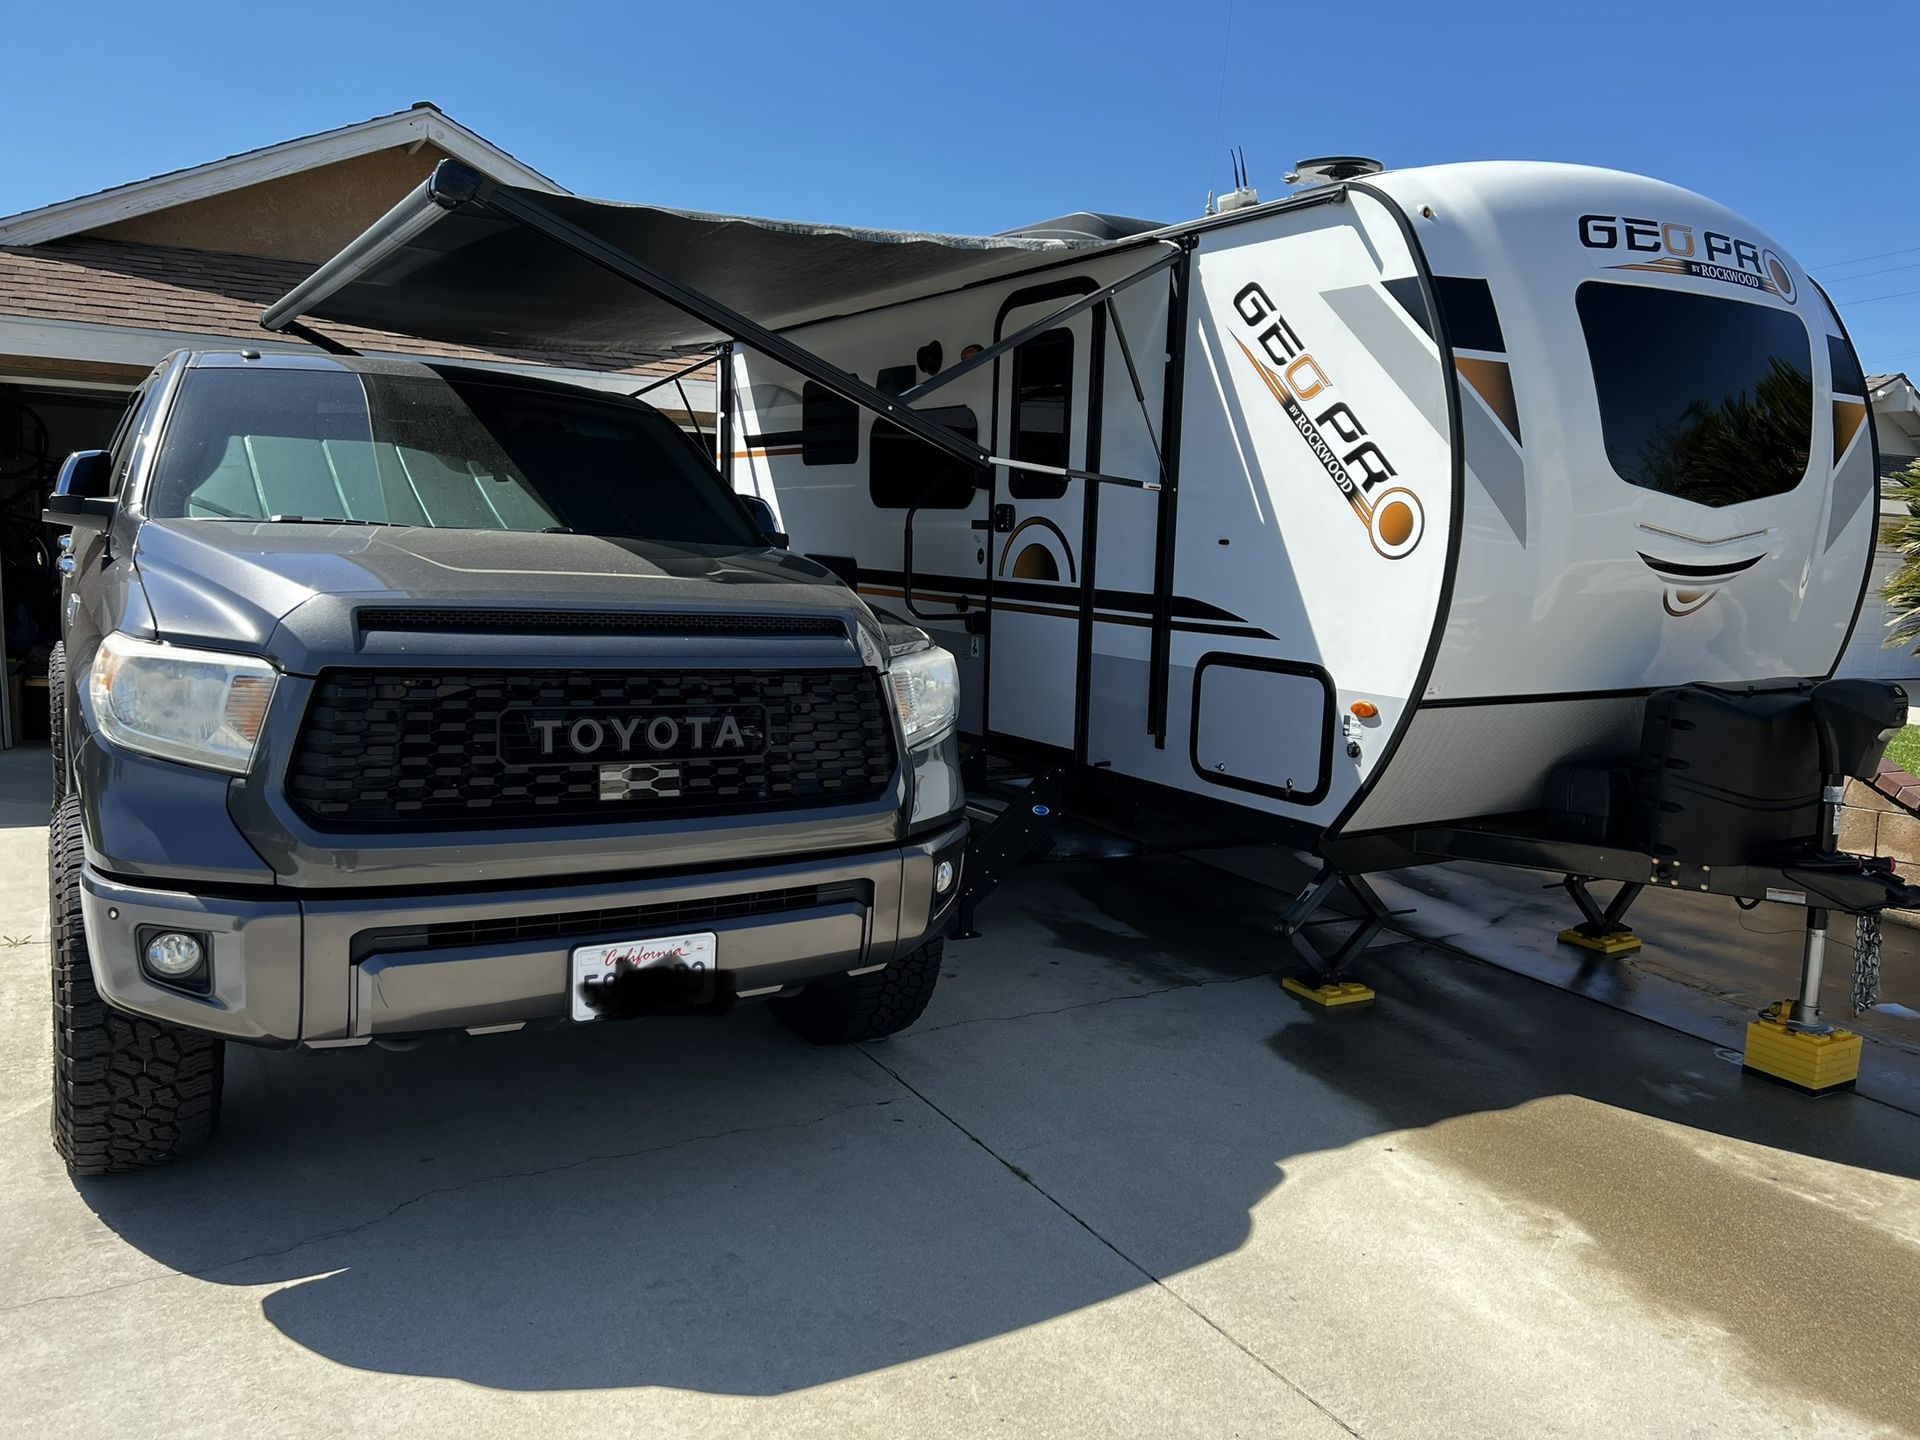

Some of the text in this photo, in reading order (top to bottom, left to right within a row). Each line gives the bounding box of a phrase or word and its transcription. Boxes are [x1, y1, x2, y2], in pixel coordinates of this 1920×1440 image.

[1578, 214, 1696, 257] GEO
[1691, 264, 1759, 287] BY ROCKWOOD
[1233, 281, 1333, 401] GEO
[1289, 404, 1353, 494] BY ROCKWOOD
[532, 714, 745, 755] TOYOTA
[604, 946, 691, 967] California
